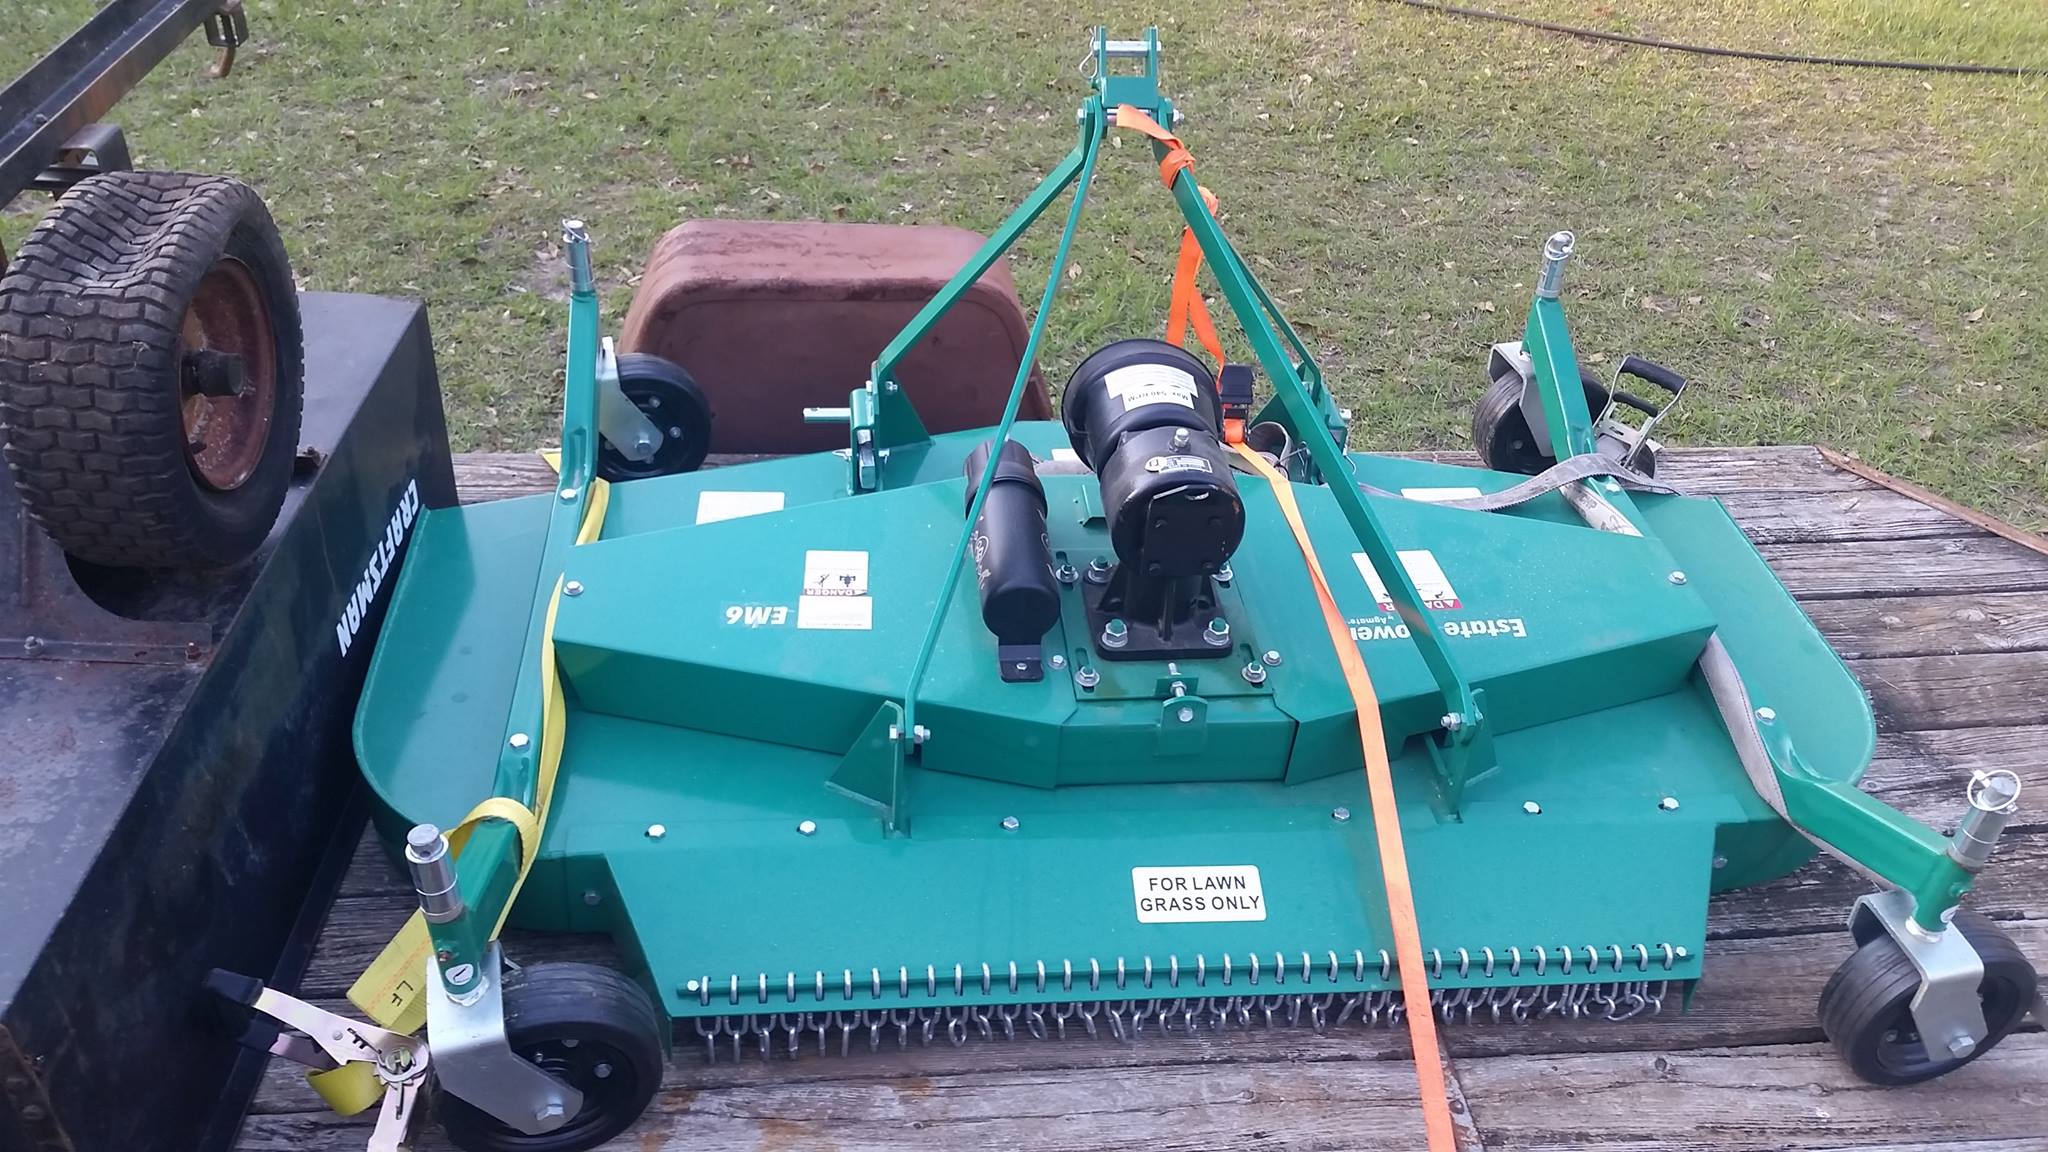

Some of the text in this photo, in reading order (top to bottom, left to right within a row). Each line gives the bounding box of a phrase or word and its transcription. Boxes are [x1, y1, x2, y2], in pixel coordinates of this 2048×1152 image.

[336, 478, 419, 658] CRAFTSMAN
[804, 588, 854, 596] DANGER
[1384, 600, 1445, 611] DAR
[726, 606, 788, 626] EM6
[1351, 618, 1527, 641] Estate ower
[1149, 876, 1246, 891] FOR LAWN
[1140, 896, 1260, 912] GRASS ONLY
